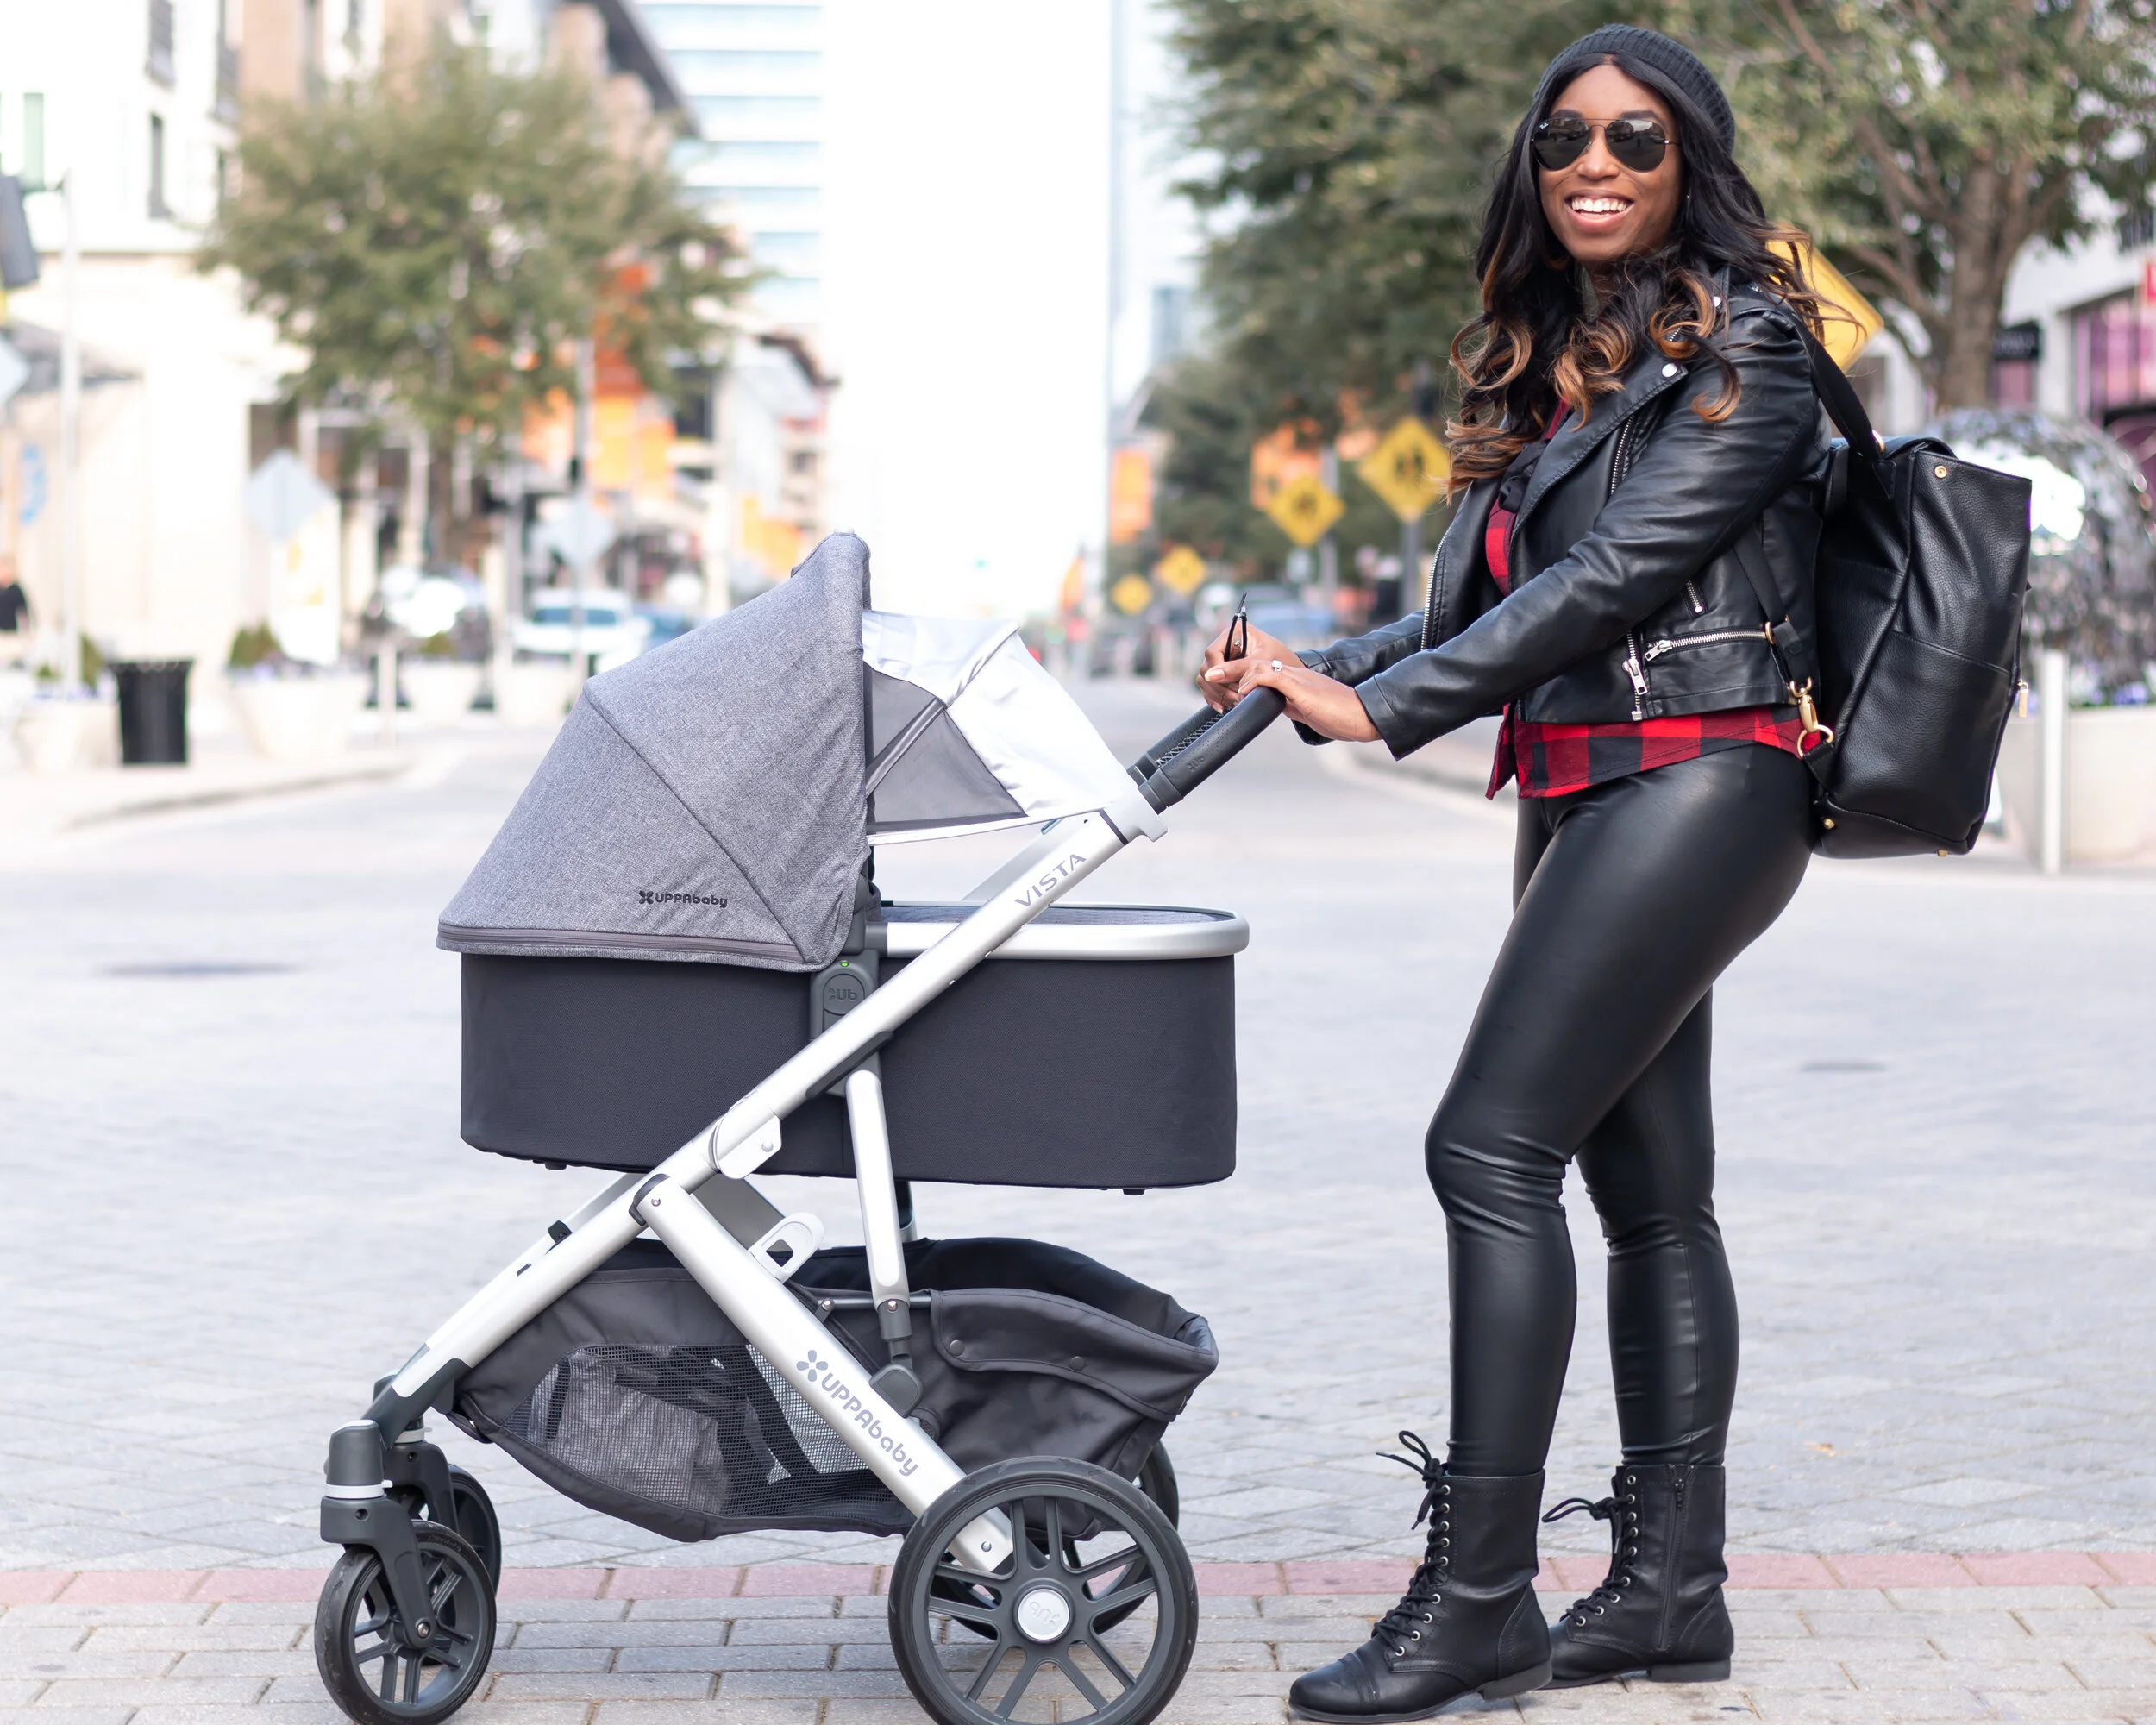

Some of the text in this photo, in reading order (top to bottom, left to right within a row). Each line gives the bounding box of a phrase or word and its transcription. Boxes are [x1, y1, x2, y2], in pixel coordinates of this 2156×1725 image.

[655, 893, 728, 908] UPPAbaby
[1014, 854, 1087, 906] VISTA
[821, 1372, 918, 1477] UPPAbaby
